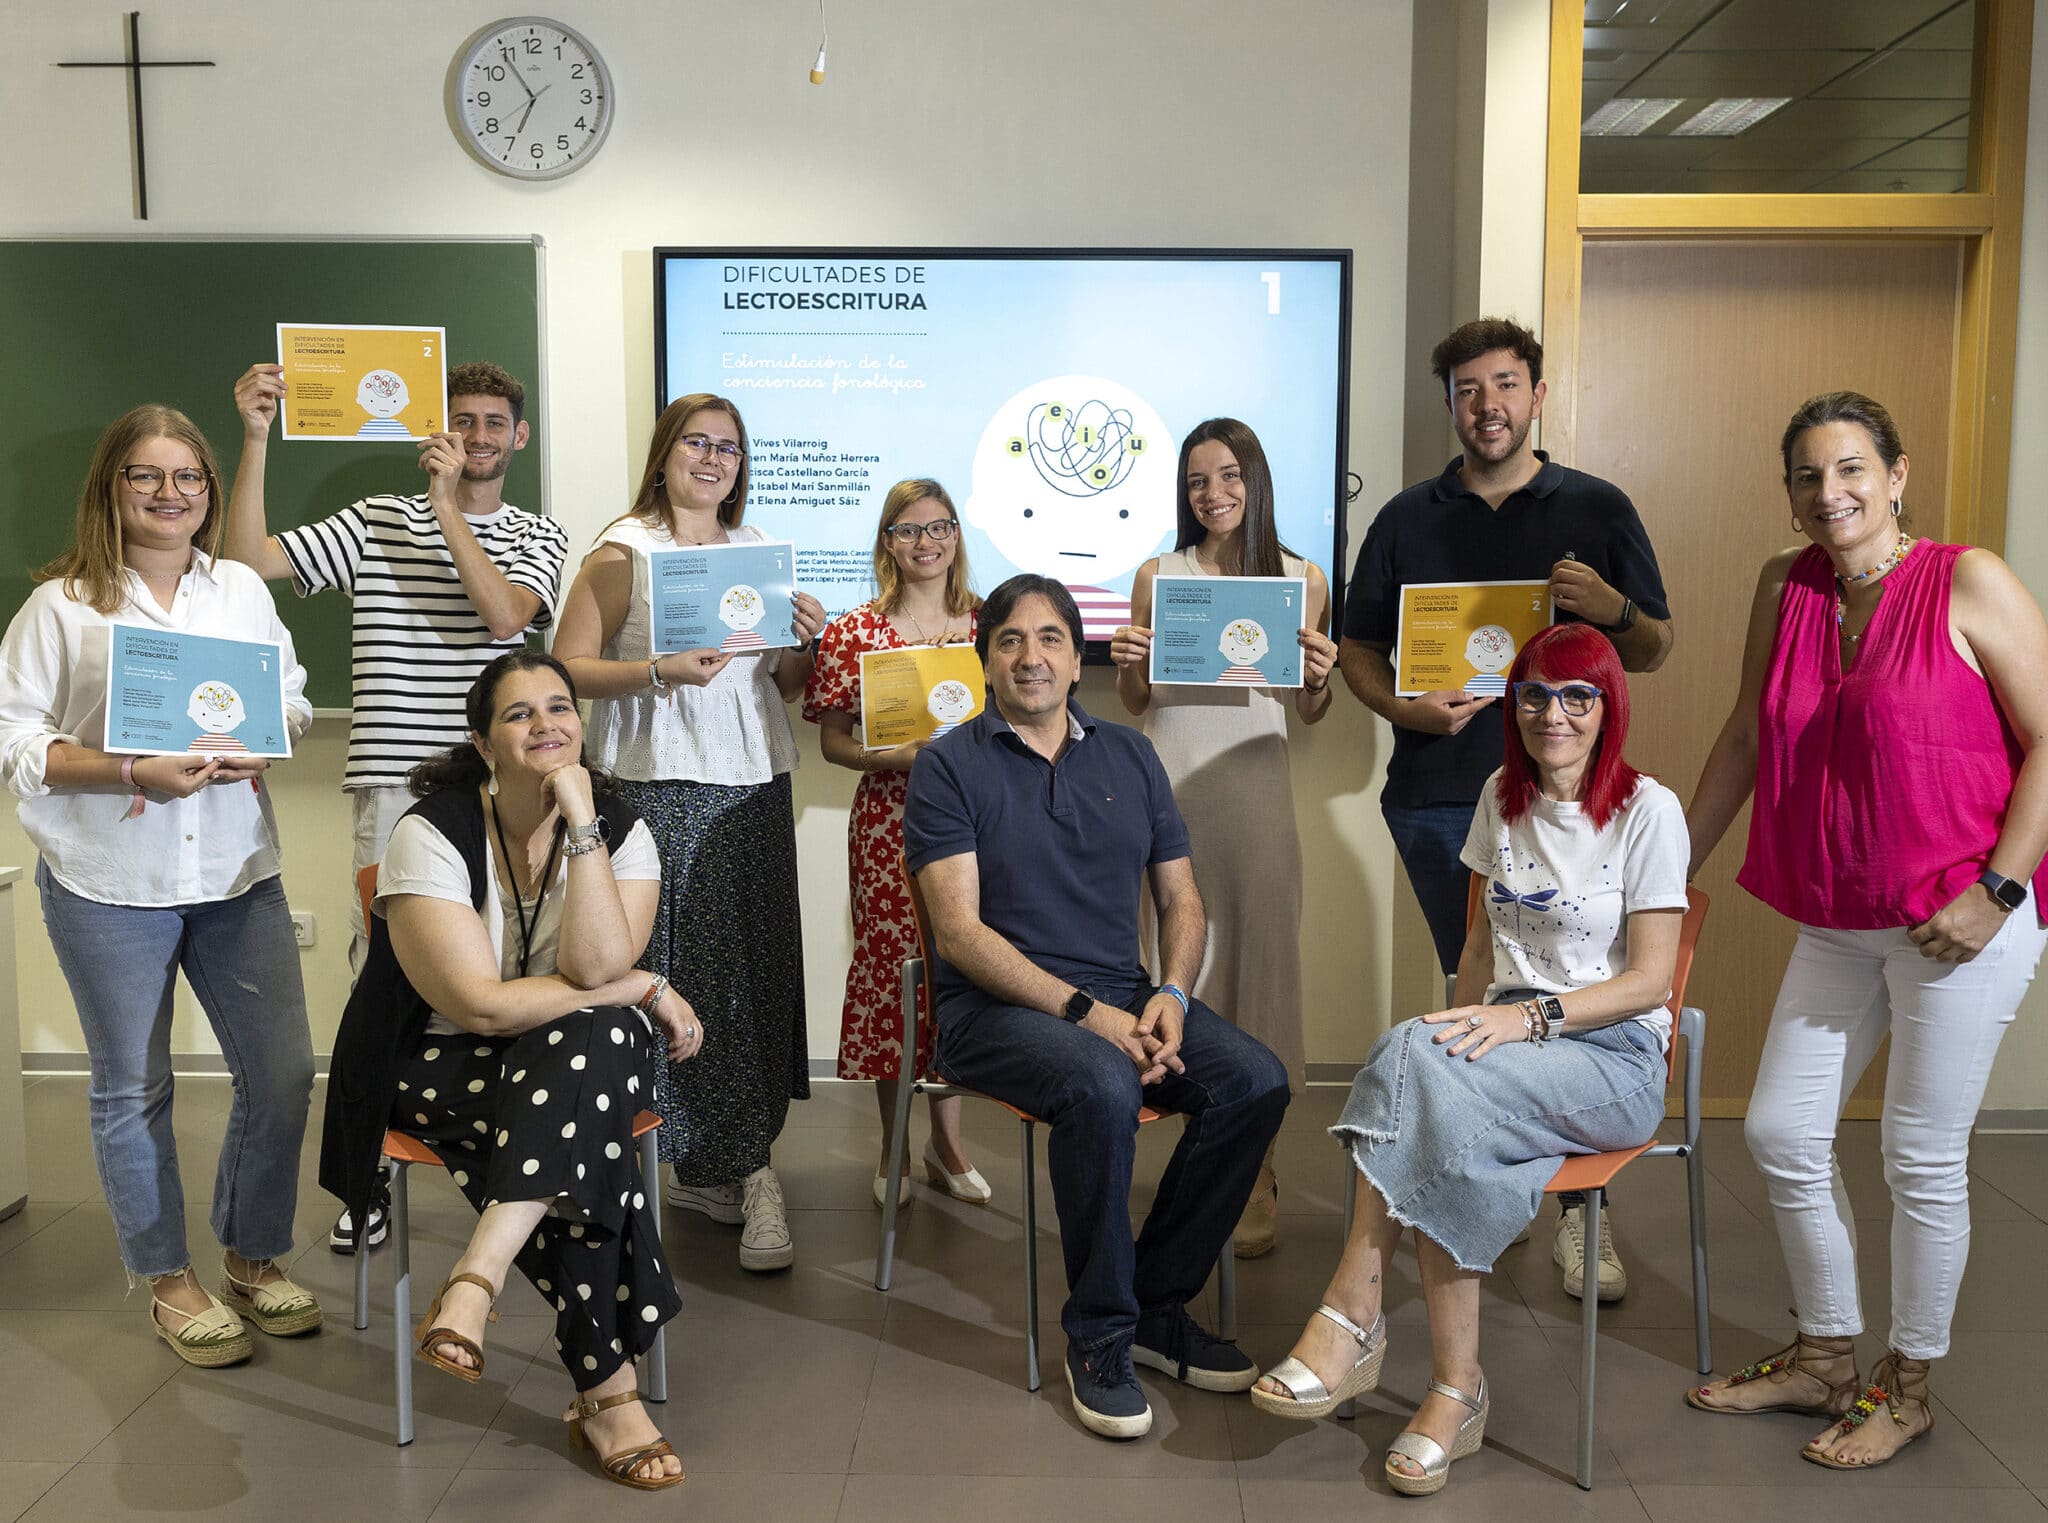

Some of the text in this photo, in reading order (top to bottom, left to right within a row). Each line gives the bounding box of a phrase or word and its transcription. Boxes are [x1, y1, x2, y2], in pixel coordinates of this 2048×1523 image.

[522, 38, 542, 54] 12
[554, 46, 560, 60] 1
[500, 47, 516, 62] 11
[483, 66, 505, 81] 10
[572, 64, 584, 78] 2
[478, 92, 490, 107] 9
[580, 89, 592, 104] 3
[486, 118, 499, 133] 8
[574, 116, 586, 130] 4
[504, 136, 516, 151] 7
[557, 135, 568, 150] 5
[530, 143, 544, 158] 6
[724, 266, 925, 284] DIFICULTADES DE
[1261, 271, 1280, 314] 1
[724, 292, 928, 310] LECTOESCRITURA
[424, 346, 432, 358] 2
[722, 352, 908, 368] Estimulación de la
[723, 372, 926, 394] conciencia fonológica
[1050, 405, 1062, 417] e
[1084, 427, 1088, 443] i
[752, 438, 828, 450] Vives Vilarroig
[1010, 440, 1022, 452] a
[1130, 439, 1142, 450] u
[770, 452, 799, 462] María
[802, 453, 837, 462] Muñoz
[841, 453, 880, 462] Herrera
[776, 467, 832, 477] Castellano
[834, 467, 869, 477] García
[1094, 468, 1106, 480] o
[757, 482, 788, 490] Isabel
[792, 482, 814, 490] Marí
[817, 482, 870, 491] Sanmillán
[758, 496, 786, 504] Elena
[790, 496, 836, 508] Amiguet
[838, 497, 860, 506] Sáiz
[776, 560, 782, 570] 1
[1285, 597, 1290, 607] 1
[1532, 600, 1541, 610] 2
[261, 660, 267, 671] 1
